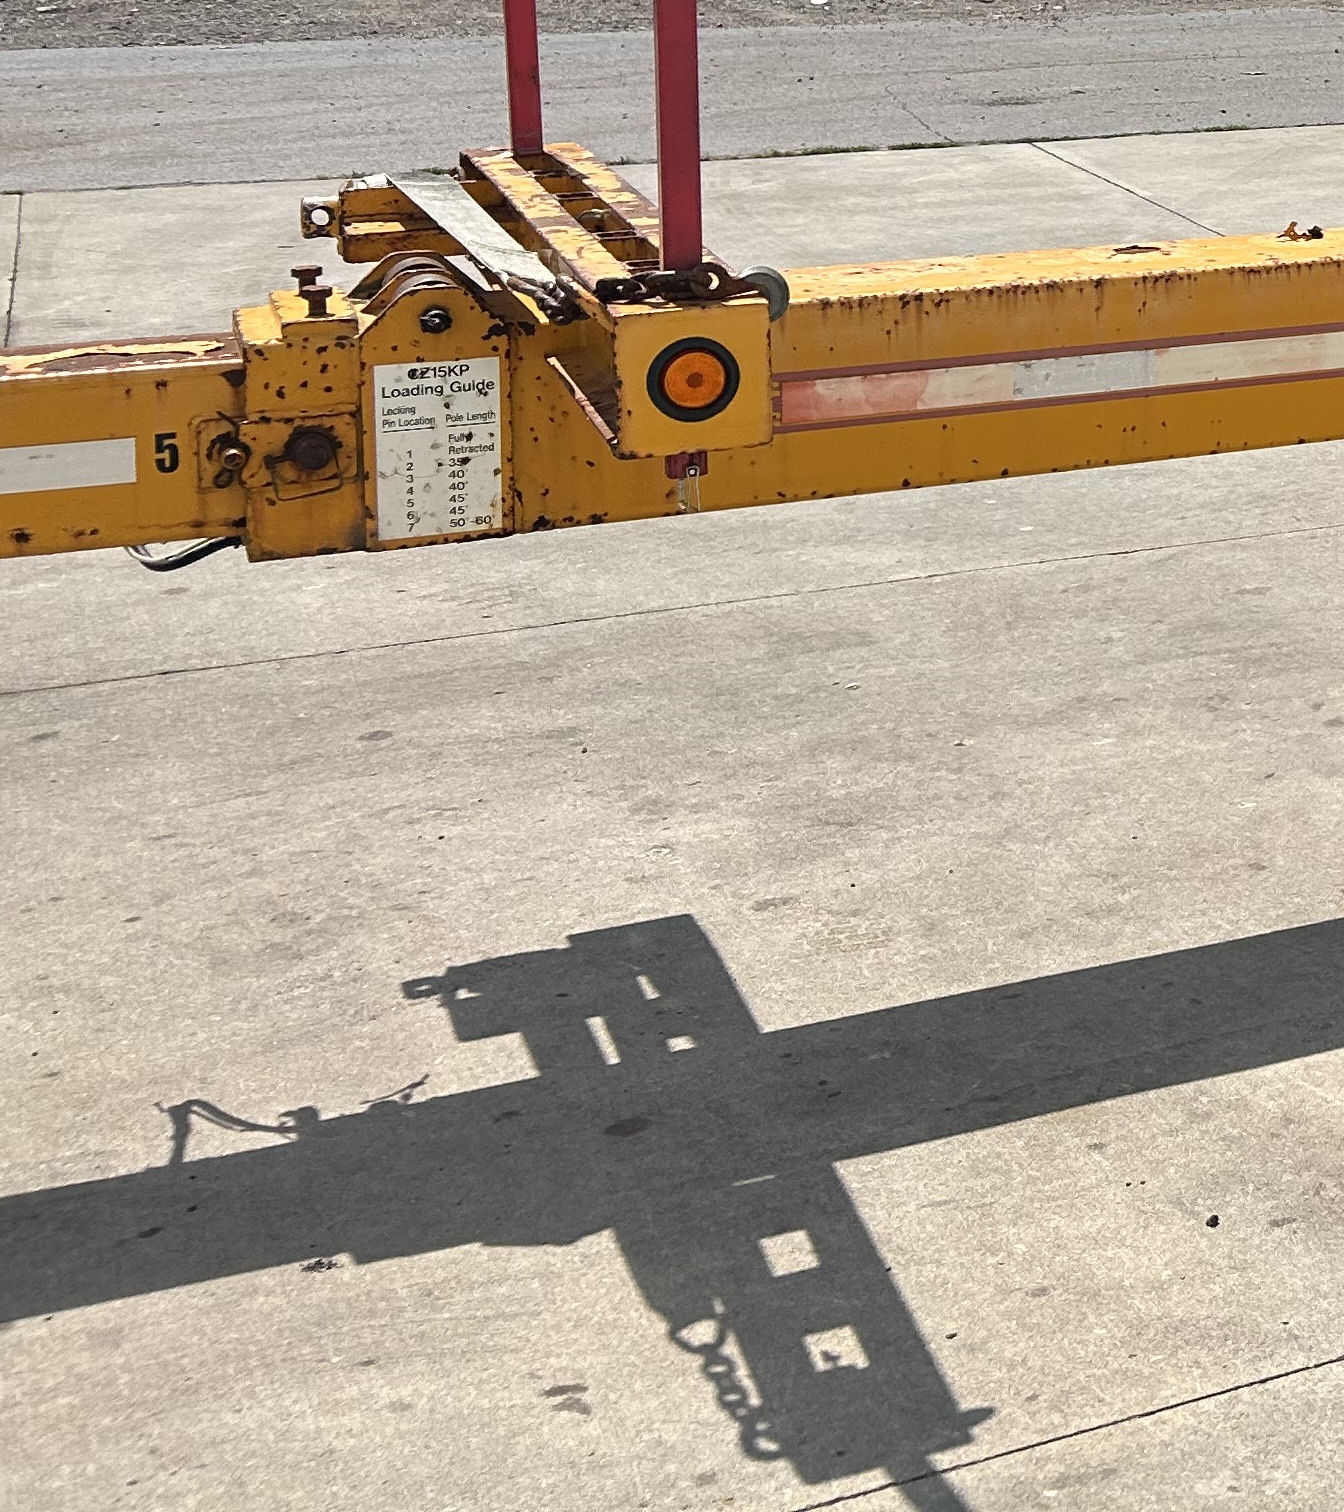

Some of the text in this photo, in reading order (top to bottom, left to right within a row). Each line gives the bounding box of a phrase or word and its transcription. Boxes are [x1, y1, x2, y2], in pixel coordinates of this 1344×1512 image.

[381, 378, 495, 399] Loading Guide
[382, 406, 416, 417] Locking
[445, 410, 496, 423] Pole Length
[381, 416, 436, 429] Pin Location
[154, 432, 179, 474] 5
[448, 442, 495, 455] Retracted
[406, 450, 413, 459] 1
[405, 462, 414, 471] 2
[405, 475, 414, 484] 3
[405, 486, 414, 495] 4
[406, 498, 414, 508] 5
[406, 511, 415, 520] 6
[407, 523, 415, 532] 7
